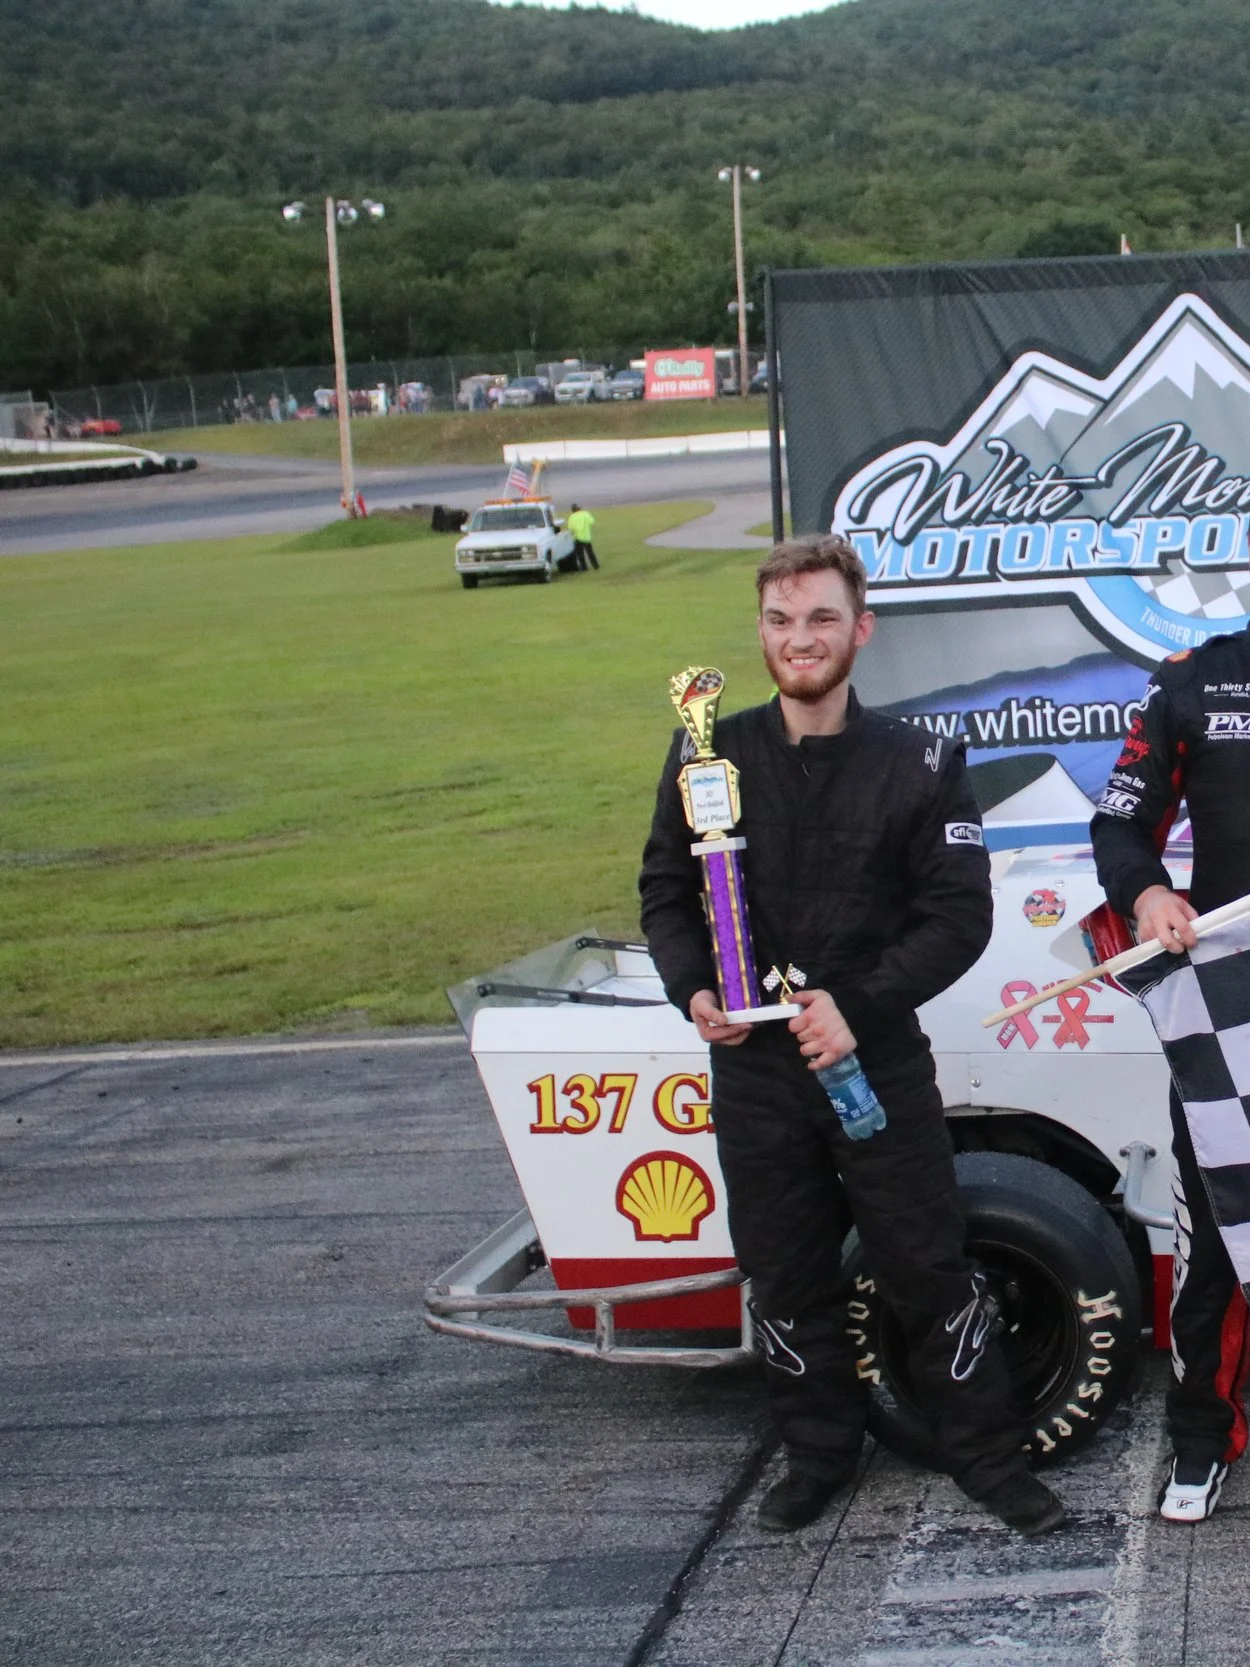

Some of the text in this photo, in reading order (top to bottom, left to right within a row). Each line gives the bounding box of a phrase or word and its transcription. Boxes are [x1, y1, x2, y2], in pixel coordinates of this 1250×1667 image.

[651, 379, 711, 393] AUTO PARTS
[847, 439, 1093, 545] White
[1141, 605, 1190, 646] THUNDER
[1204, 684, 1218, 692] One
[1220, 682, 1243, 692] Thirty
[696, 813, 731, 824] 3rd Place
[526, 1073, 639, 1135] 137
[1035, 1288, 1124, 1453] Hoosier
